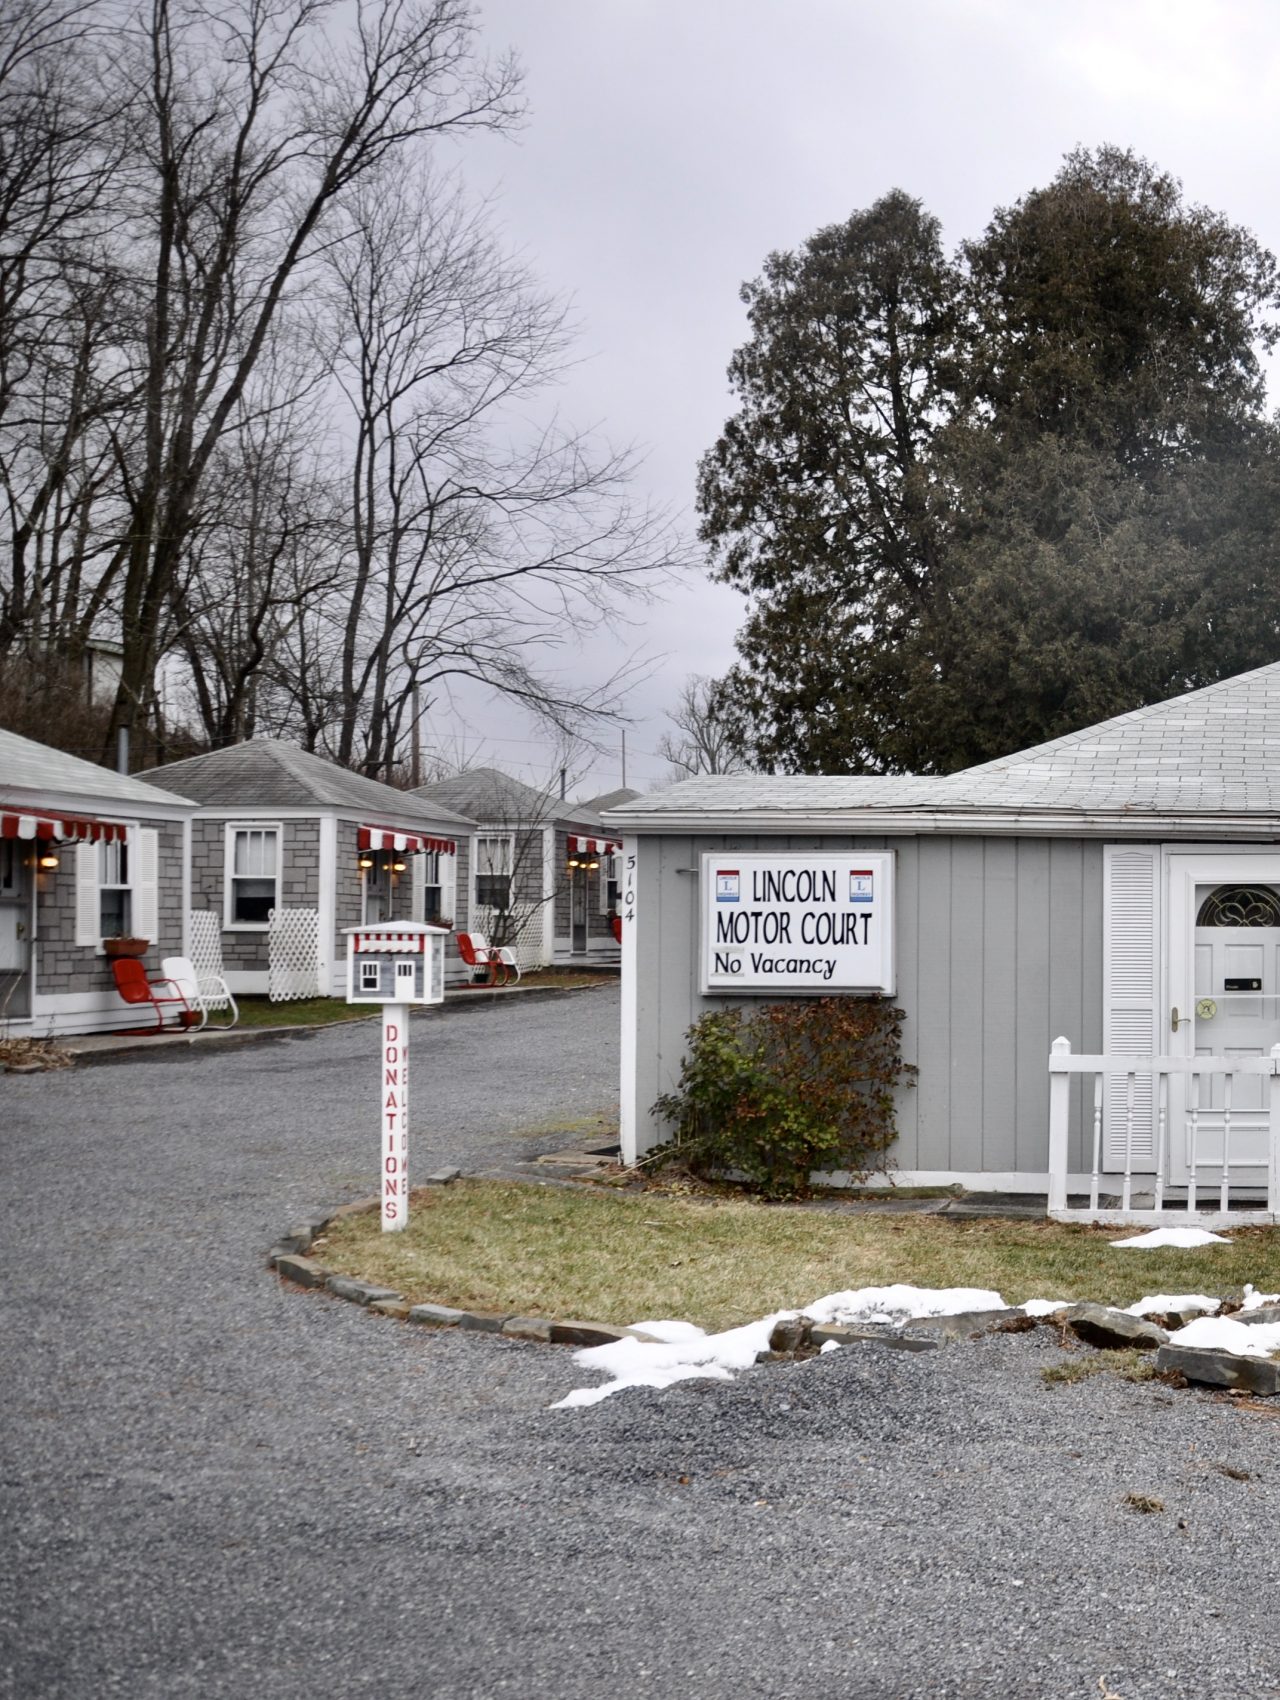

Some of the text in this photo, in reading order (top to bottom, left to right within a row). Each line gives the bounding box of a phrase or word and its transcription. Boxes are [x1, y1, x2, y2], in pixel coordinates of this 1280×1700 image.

[625, 855, 636, 922] 5104
[753, 870, 836, 902] LINCOLN
[717, 911, 872, 945] MOTOR COURT
[714, 952, 837, 980] No Vacancy
[385, 1024, 398, 1219] DONATIONS
